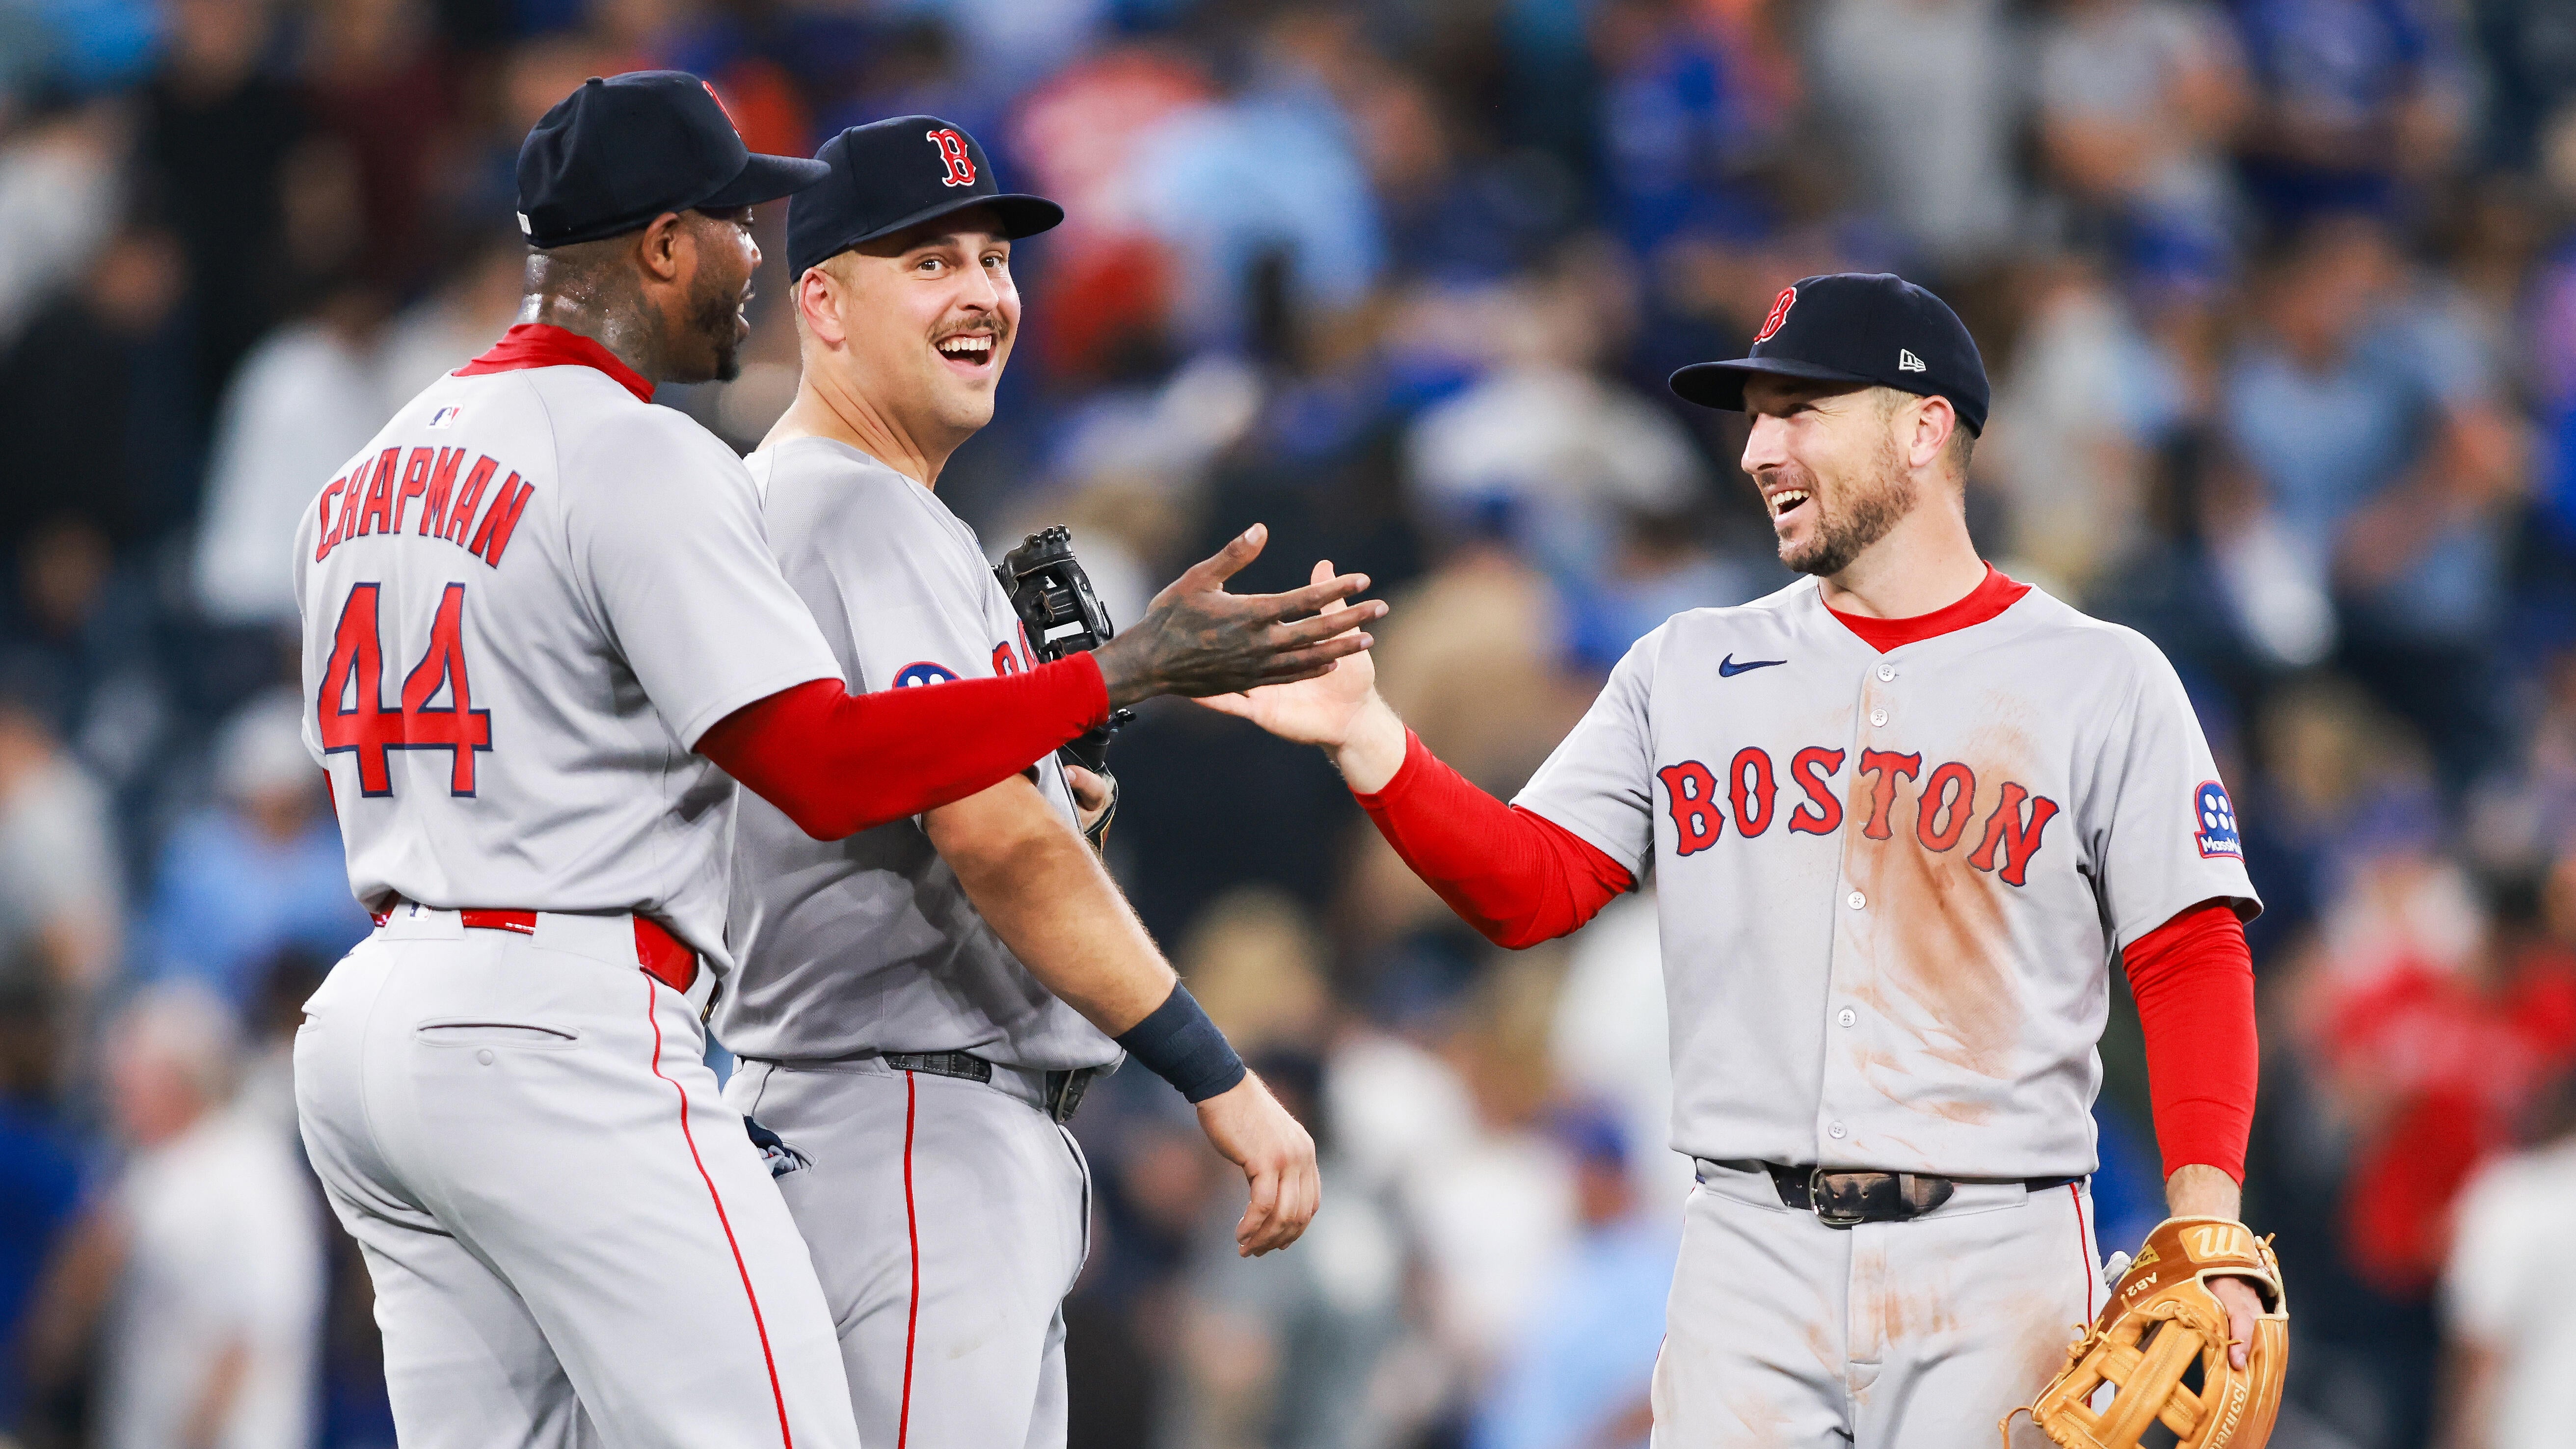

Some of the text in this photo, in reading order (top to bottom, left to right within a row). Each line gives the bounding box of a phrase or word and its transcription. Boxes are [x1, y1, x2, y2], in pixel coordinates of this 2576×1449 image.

[926, 129, 977, 187] B
[1753, 287, 1797, 345] B
[316, 447, 534, 568] CHAPMAN
[317, 582, 493, 798] 44
[1656, 746, 2060, 887] BOSTON
[2126, 1271, 2157, 1297] AB2
